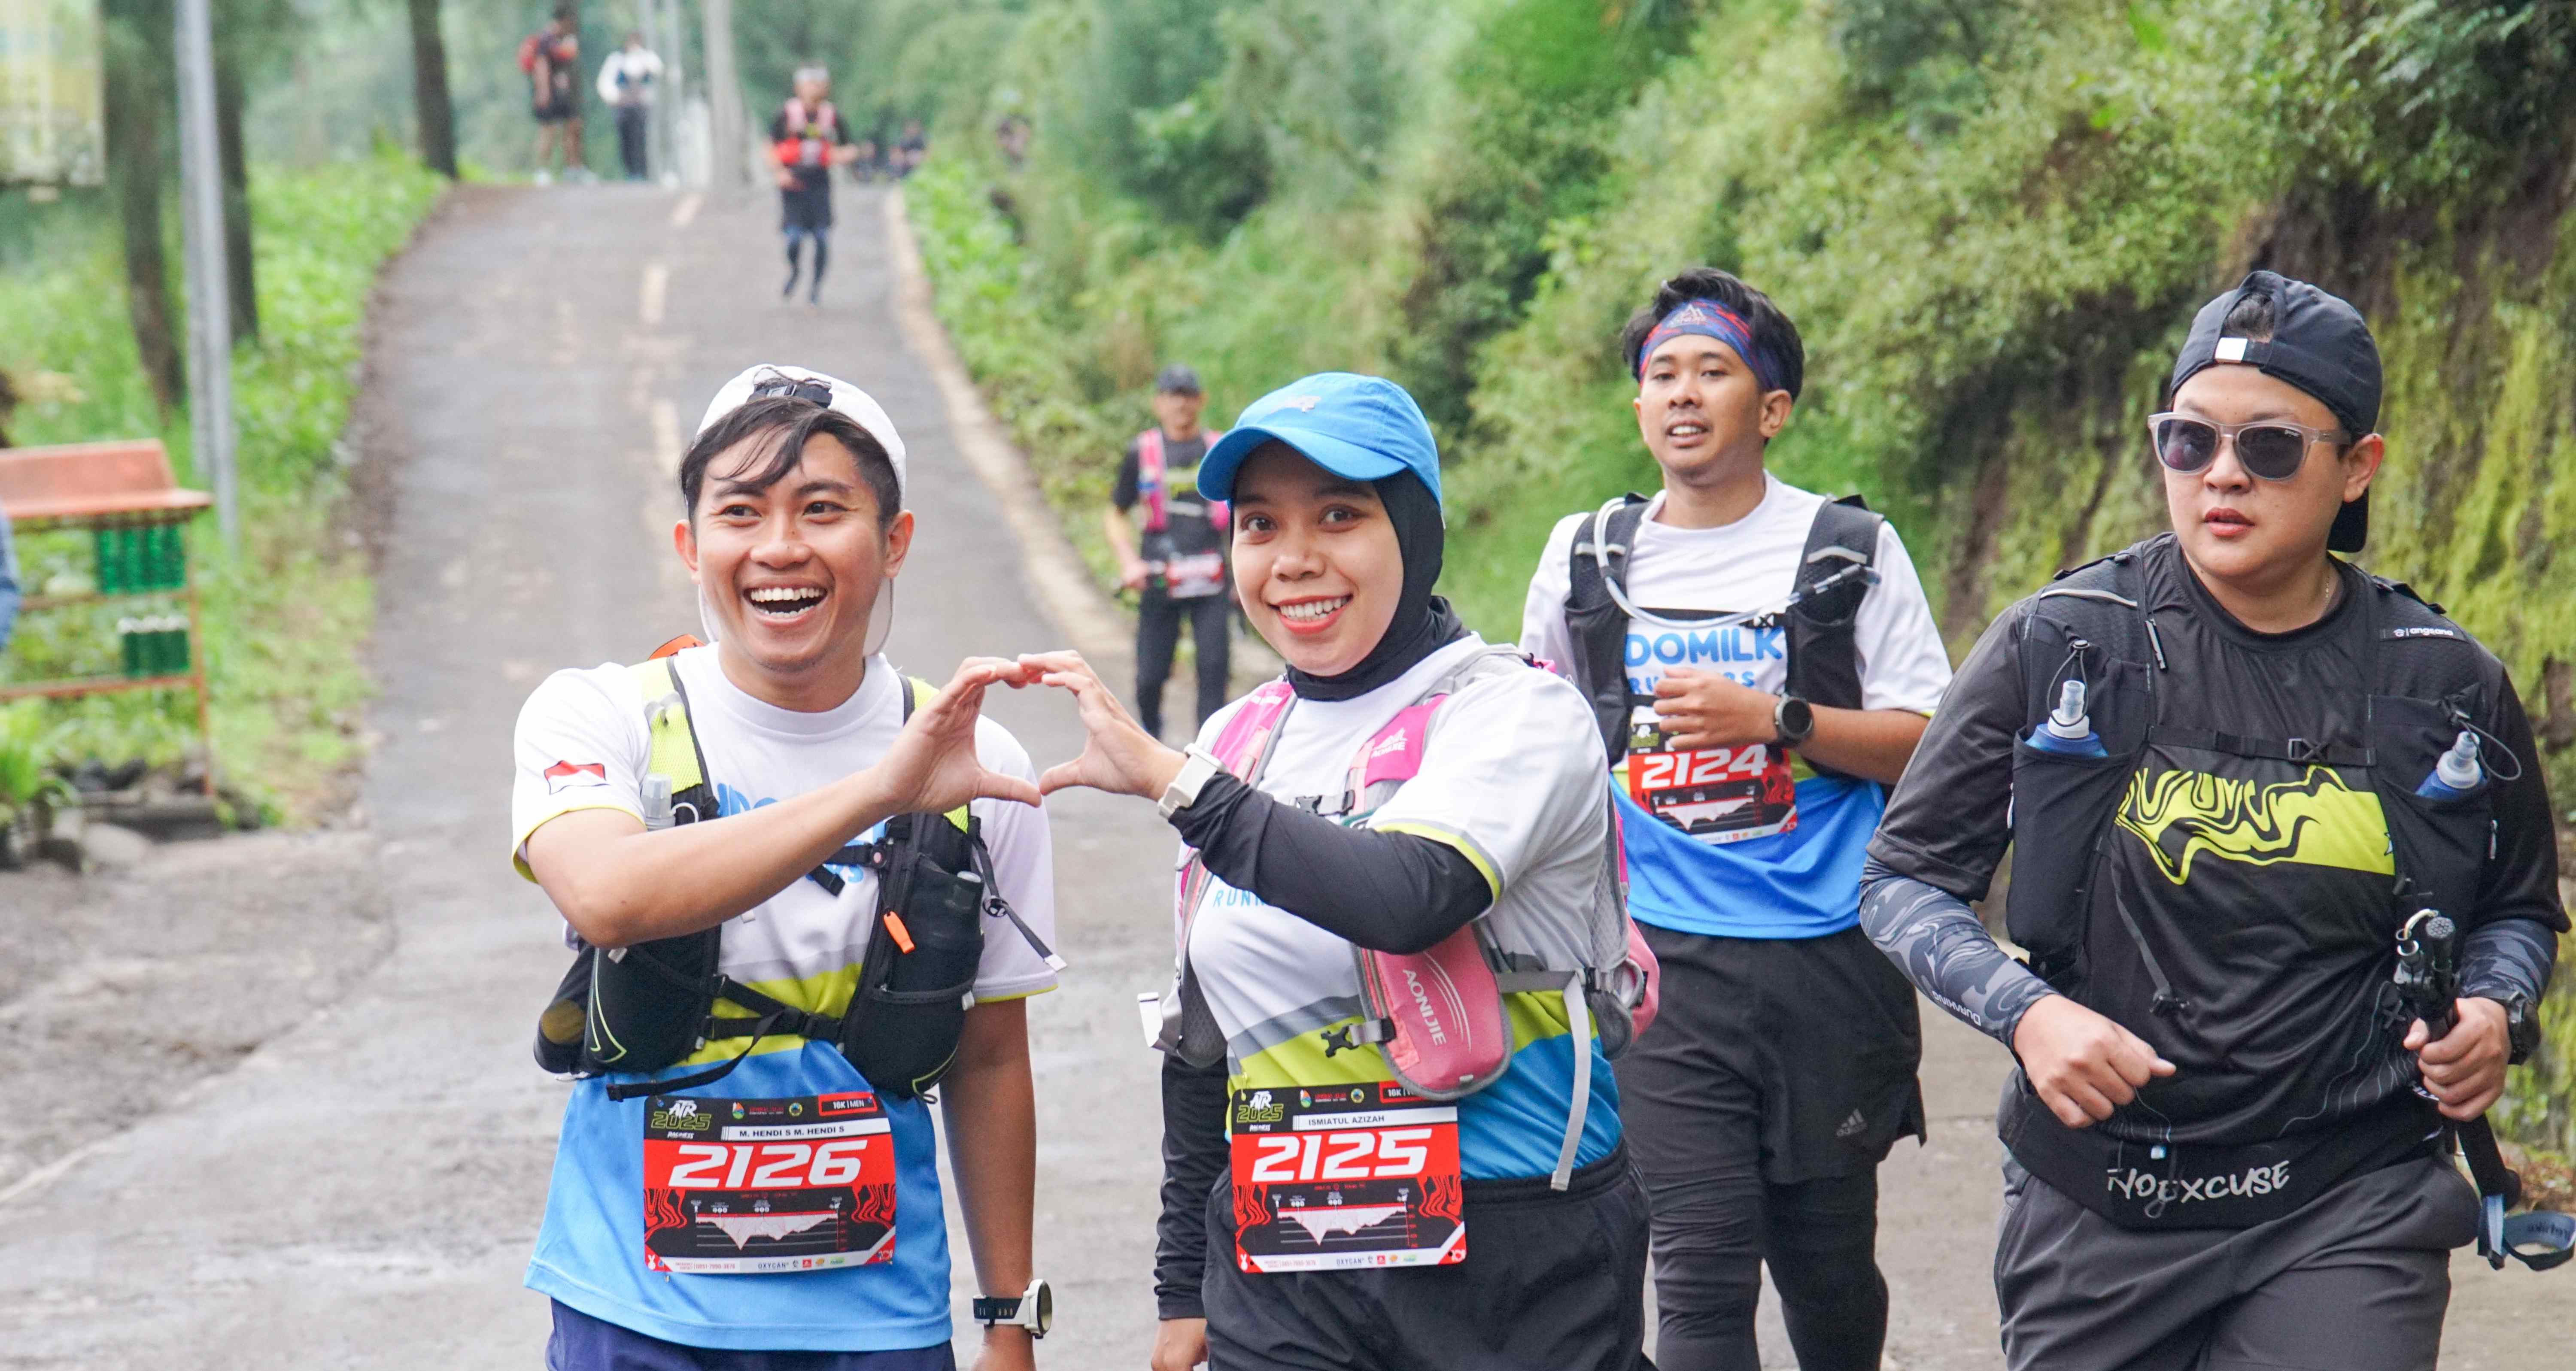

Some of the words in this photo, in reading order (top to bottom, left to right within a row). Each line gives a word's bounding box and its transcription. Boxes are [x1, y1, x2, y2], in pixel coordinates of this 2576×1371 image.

[1641, 744, 1768, 789] 2124
[1402, 969, 1447, 1046] AONIJIE
[849, 1099, 865, 1108] MEN
[1236, 1103, 1284, 1123] 2025
[651, 1111, 712, 1131] 2025
[807, 1126, 836, 1135] HENDI
[1309, 1116, 1349, 1126] ISMIATUL
[1352, 1115, 1385, 1124] AZIZAH
[668, 1139, 868, 1188] 2126
[1252, 1128, 1432, 1182] 2125
